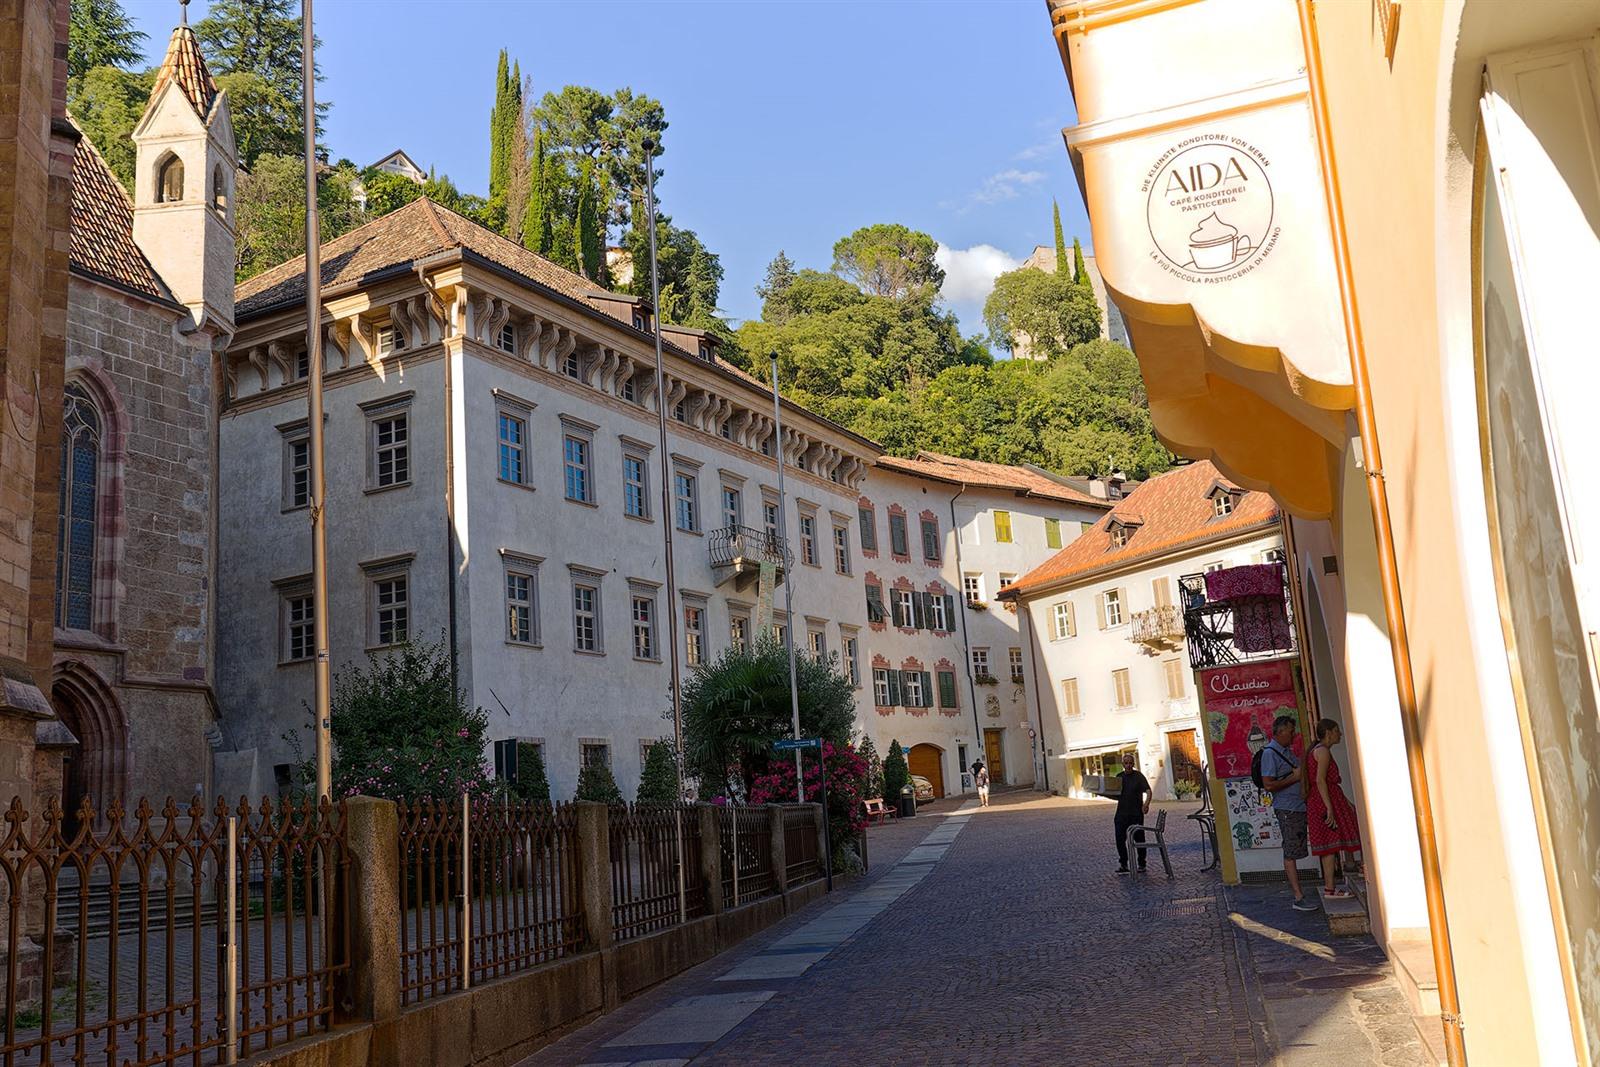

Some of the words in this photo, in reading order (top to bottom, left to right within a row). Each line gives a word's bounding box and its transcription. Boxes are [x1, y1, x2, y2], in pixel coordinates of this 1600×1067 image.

[1141, 179, 1151, 193] DIE
[1148, 147, 1177, 178] KLEINSTE
[1178, 134, 1229, 149] KONDITOREI
[1231, 136, 1248, 148] VON
[1248, 145, 1270, 167] MERAN
[1164, 157, 1249, 198] AIDA
[1181, 196, 1237, 212] PASTICCERIA
[1194, 186, 1246, 202] KONDITOREI
[1149, 251, 1159, 260] LA
[1169, 268, 1201, 284] PICCOLA
[1204, 264, 1254, 284] PASTICCERIA
[1254, 257, 1263, 266] DI
[1262, 226, 1281, 258] MERANO
[1210, 673, 1270, 693] Claudia
